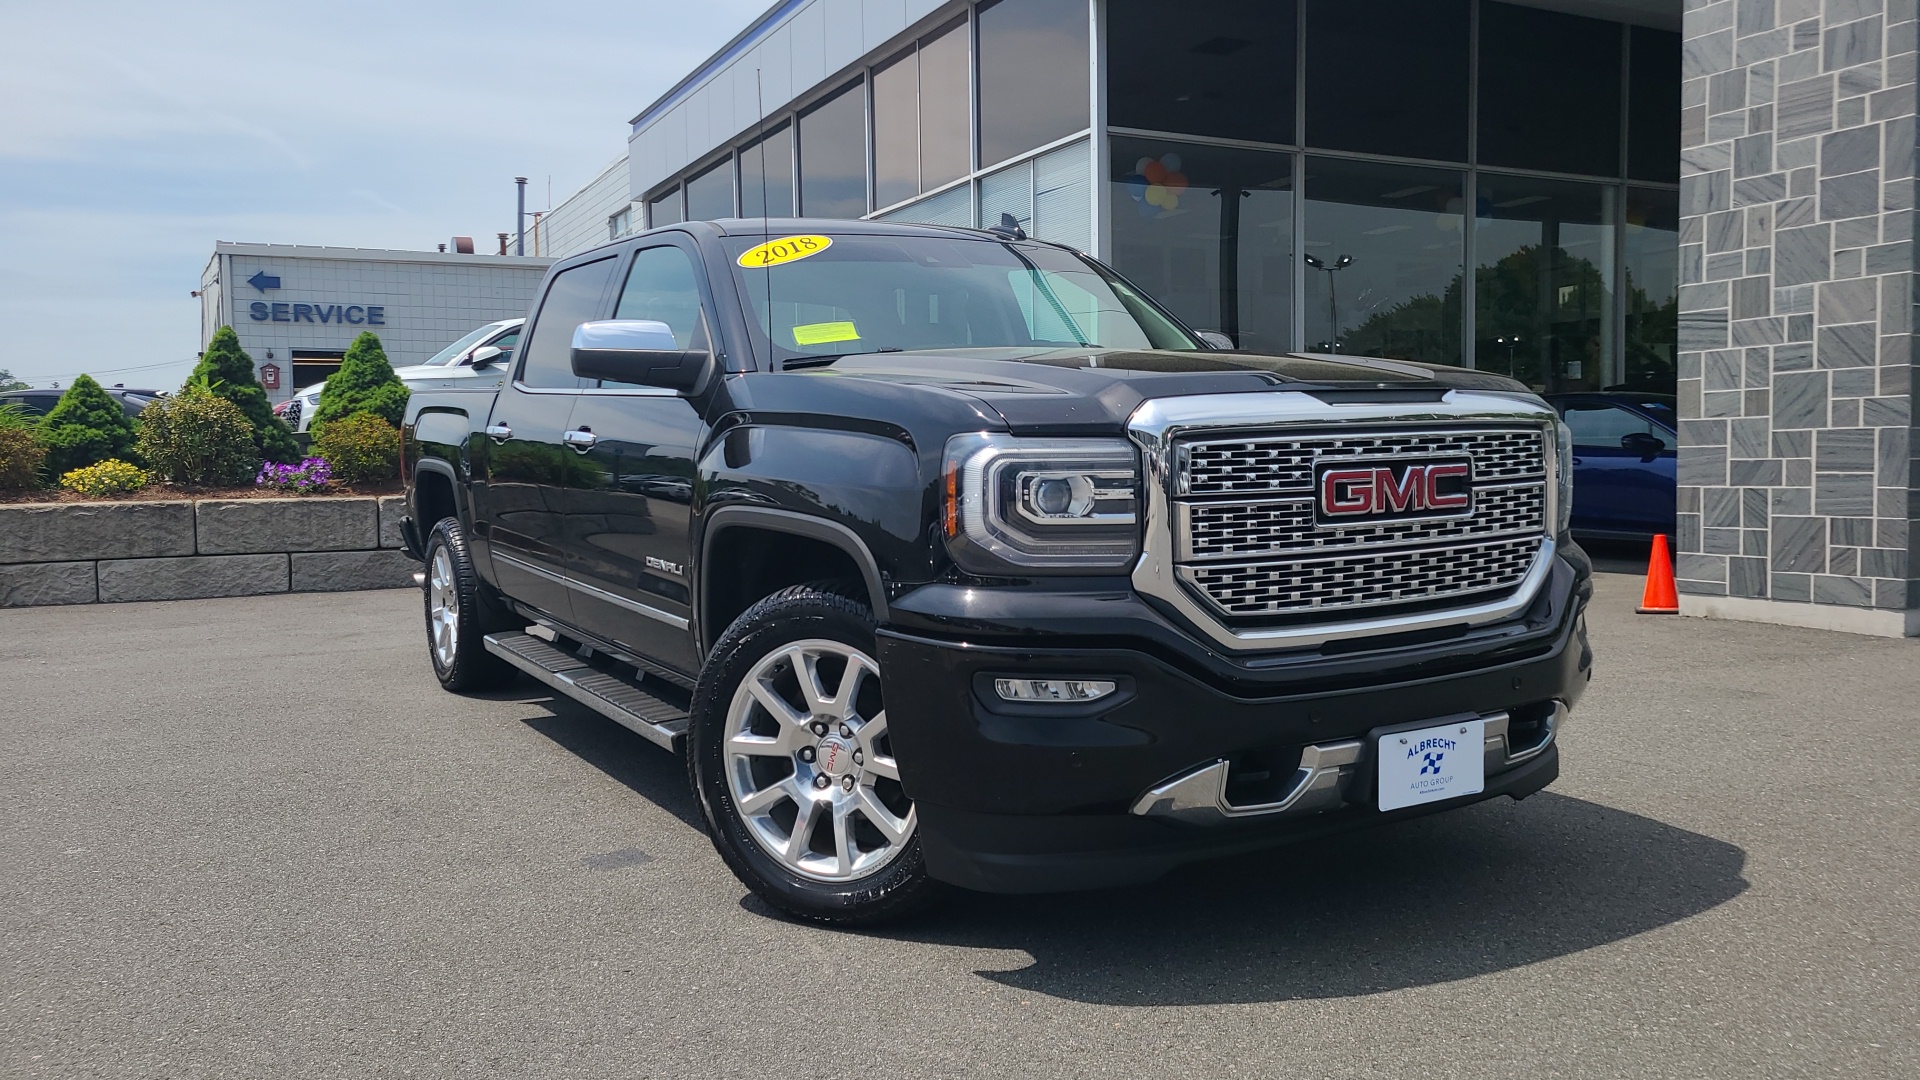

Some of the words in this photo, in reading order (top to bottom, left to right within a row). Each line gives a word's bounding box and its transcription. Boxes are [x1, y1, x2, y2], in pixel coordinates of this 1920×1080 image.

[756, 237, 818, 264] 2018
[250, 302, 385, 325] SERVICE
[1322, 463, 1468, 517] GMC
[645, 556, 684, 576] DENALI
[826, 742, 840, 772] GMC
[1407, 738, 1457, 759] ALBRECHT
[1410, 780, 1429, 790] AUTO
[1430, 776, 1454, 786] GROUP
